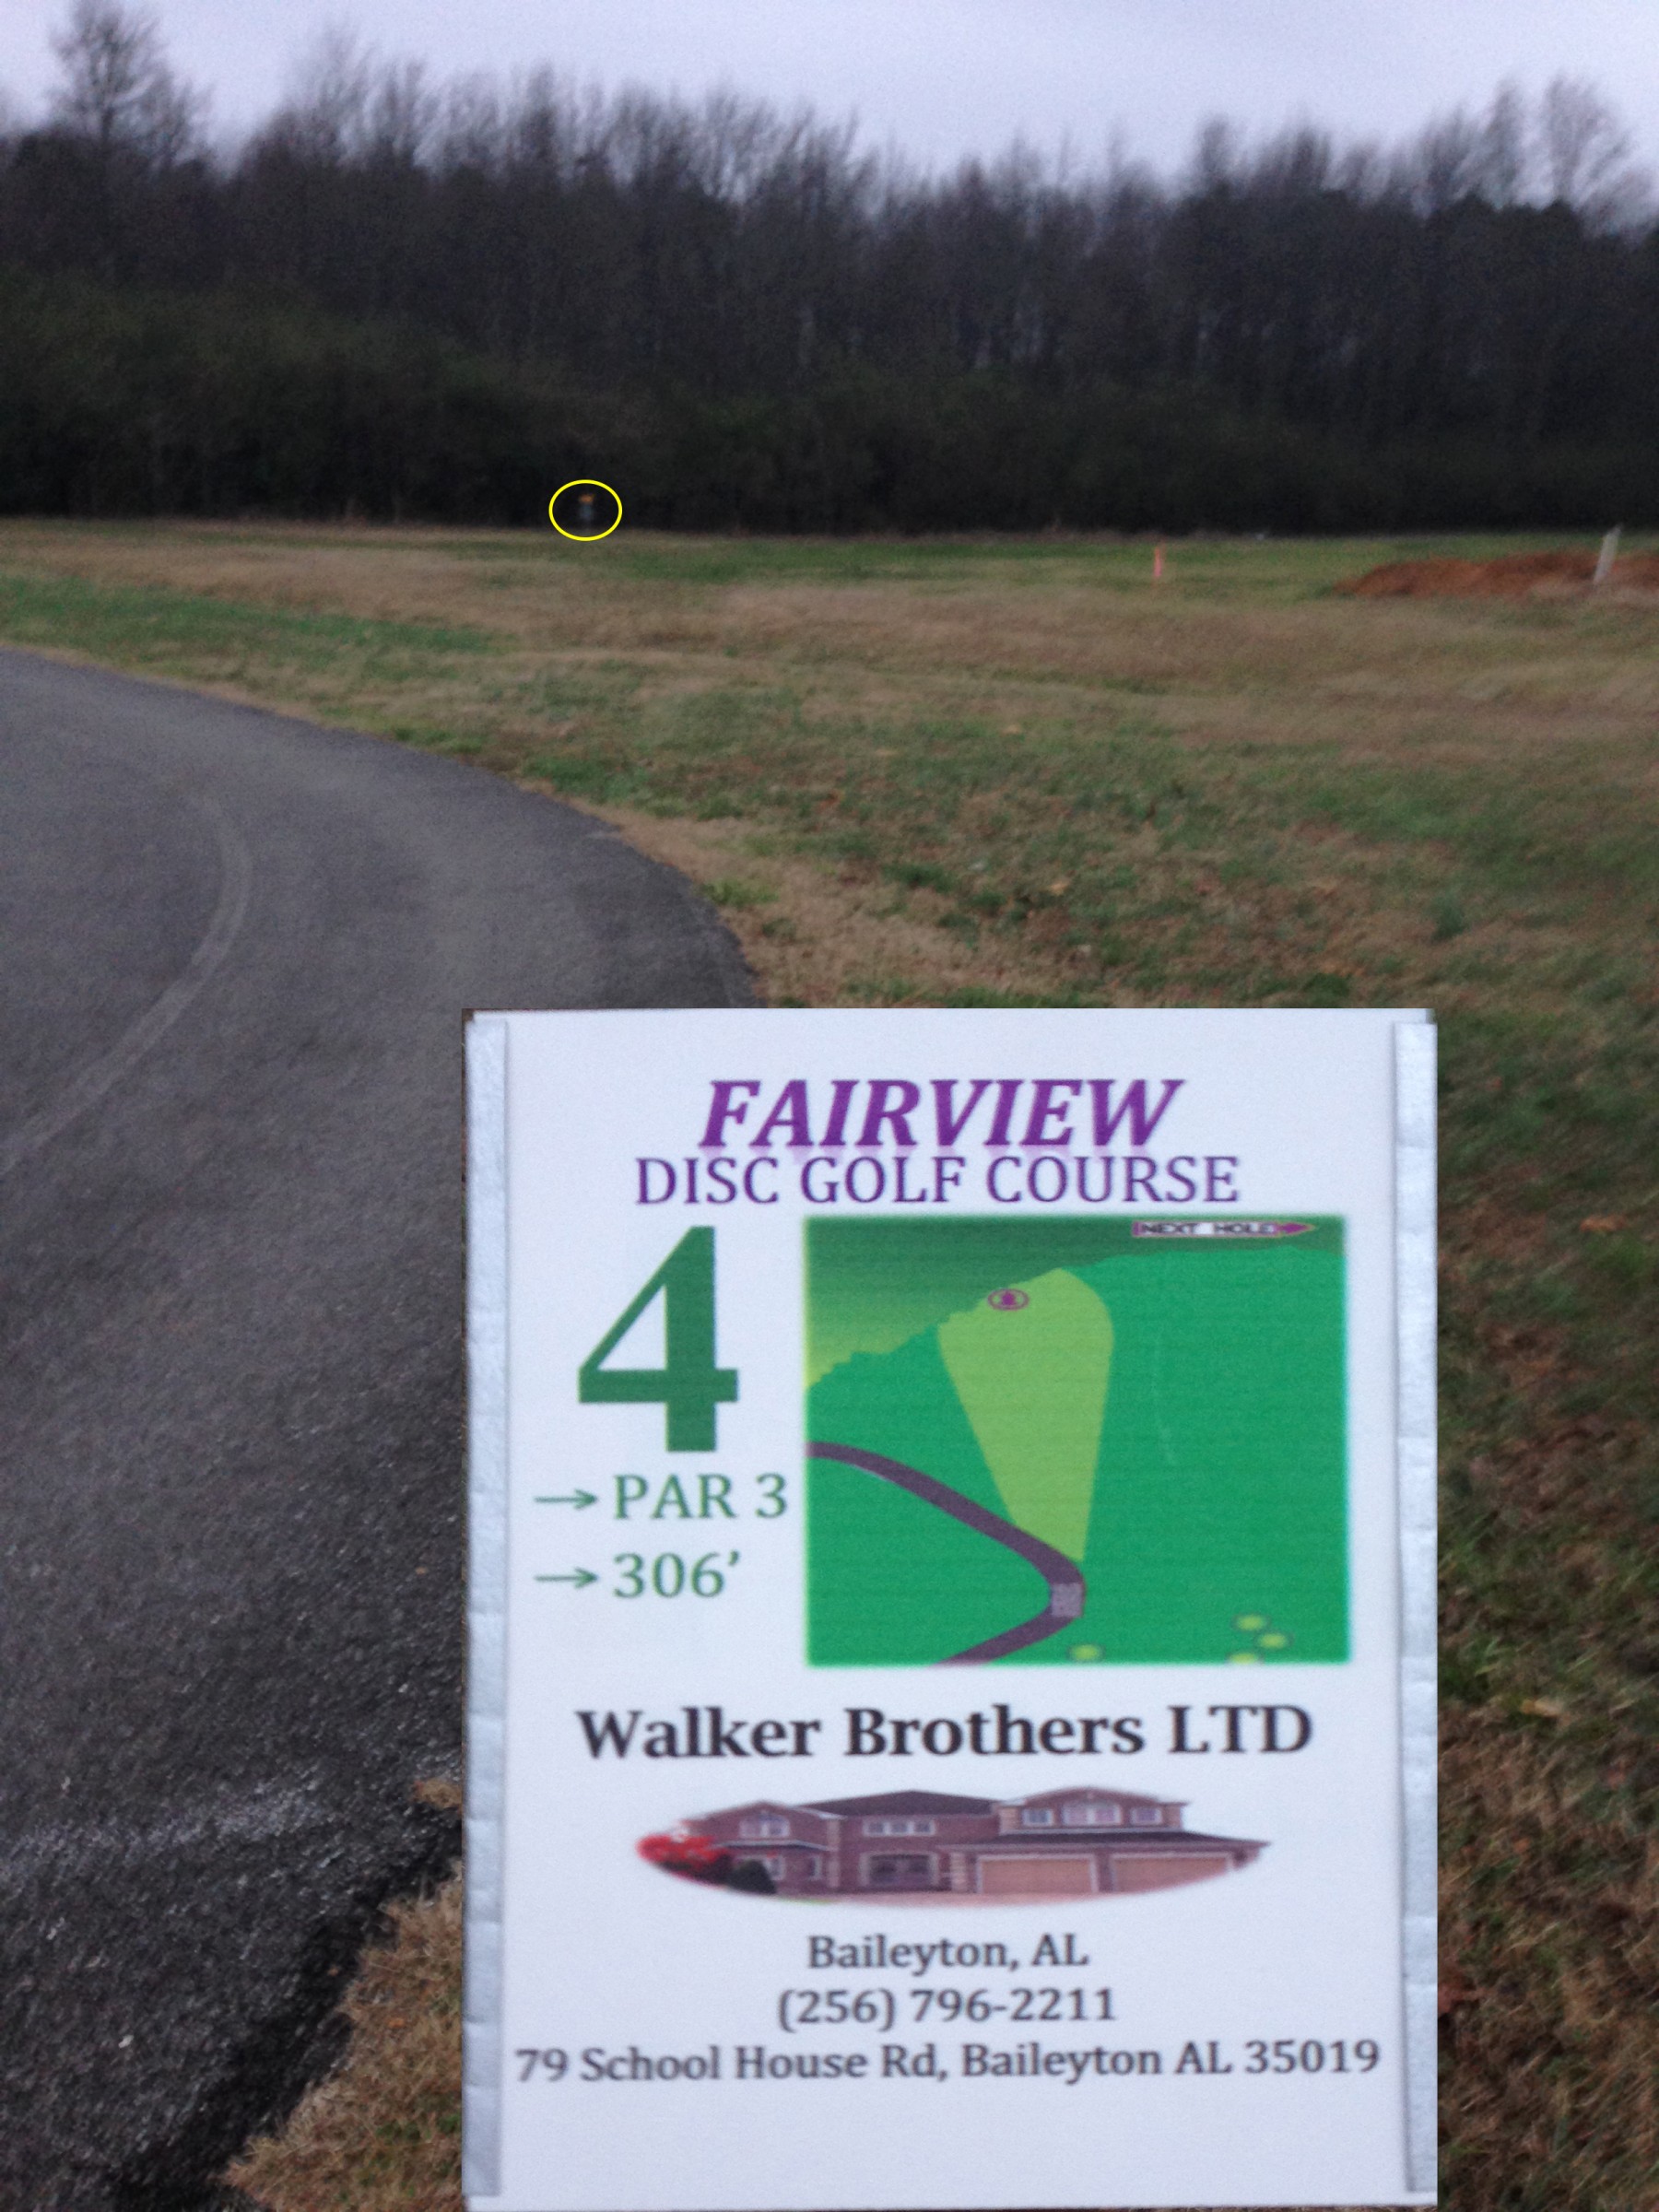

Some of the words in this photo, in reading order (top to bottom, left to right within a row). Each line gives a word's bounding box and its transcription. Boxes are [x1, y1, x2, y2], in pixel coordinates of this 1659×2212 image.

[698, 1078, 1185, 1148] FAIRVIEW
[636, 1156, 780, 1205] DISC
[800, 1155, 966, 1205] GOLF
[985, 1155, 1239, 1204] COURSE
[1141, 1221, 1198, 1235] NEXT
[1214, 1221, 1276, 1235] HOLE
[578, 1225, 740, 1453] 4
[614, 1473, 738, 1520] PAR
[756, 1472, 788, 1519] 3
[614, 1550, 741, 1599] 306'
[575, 1706, 822, 1759] Walker
[844, 1703, 1146, 1757] Brothers
[1169, 1704, 1313, 1754] LTD
[808, 1933, 1020, 1976] Baileyton,
[1031, 1933, 1090, 1967] AL
[778, 1987, 898, 2032] (256)
[910, 1987, 1116, 2023] 796-2211
[515, 2047, 569, 2082] 79
[580, 2044, 723, 2082] School
[735, 2046, 868, 2079] House
[881, 2043, 948, 2084] Rd,
[961, 2042, 1162, 2085] Baileyton
[1174, 2041, 1233, 2076] AL
[1244, 2040, 1381, 2076] 35019
